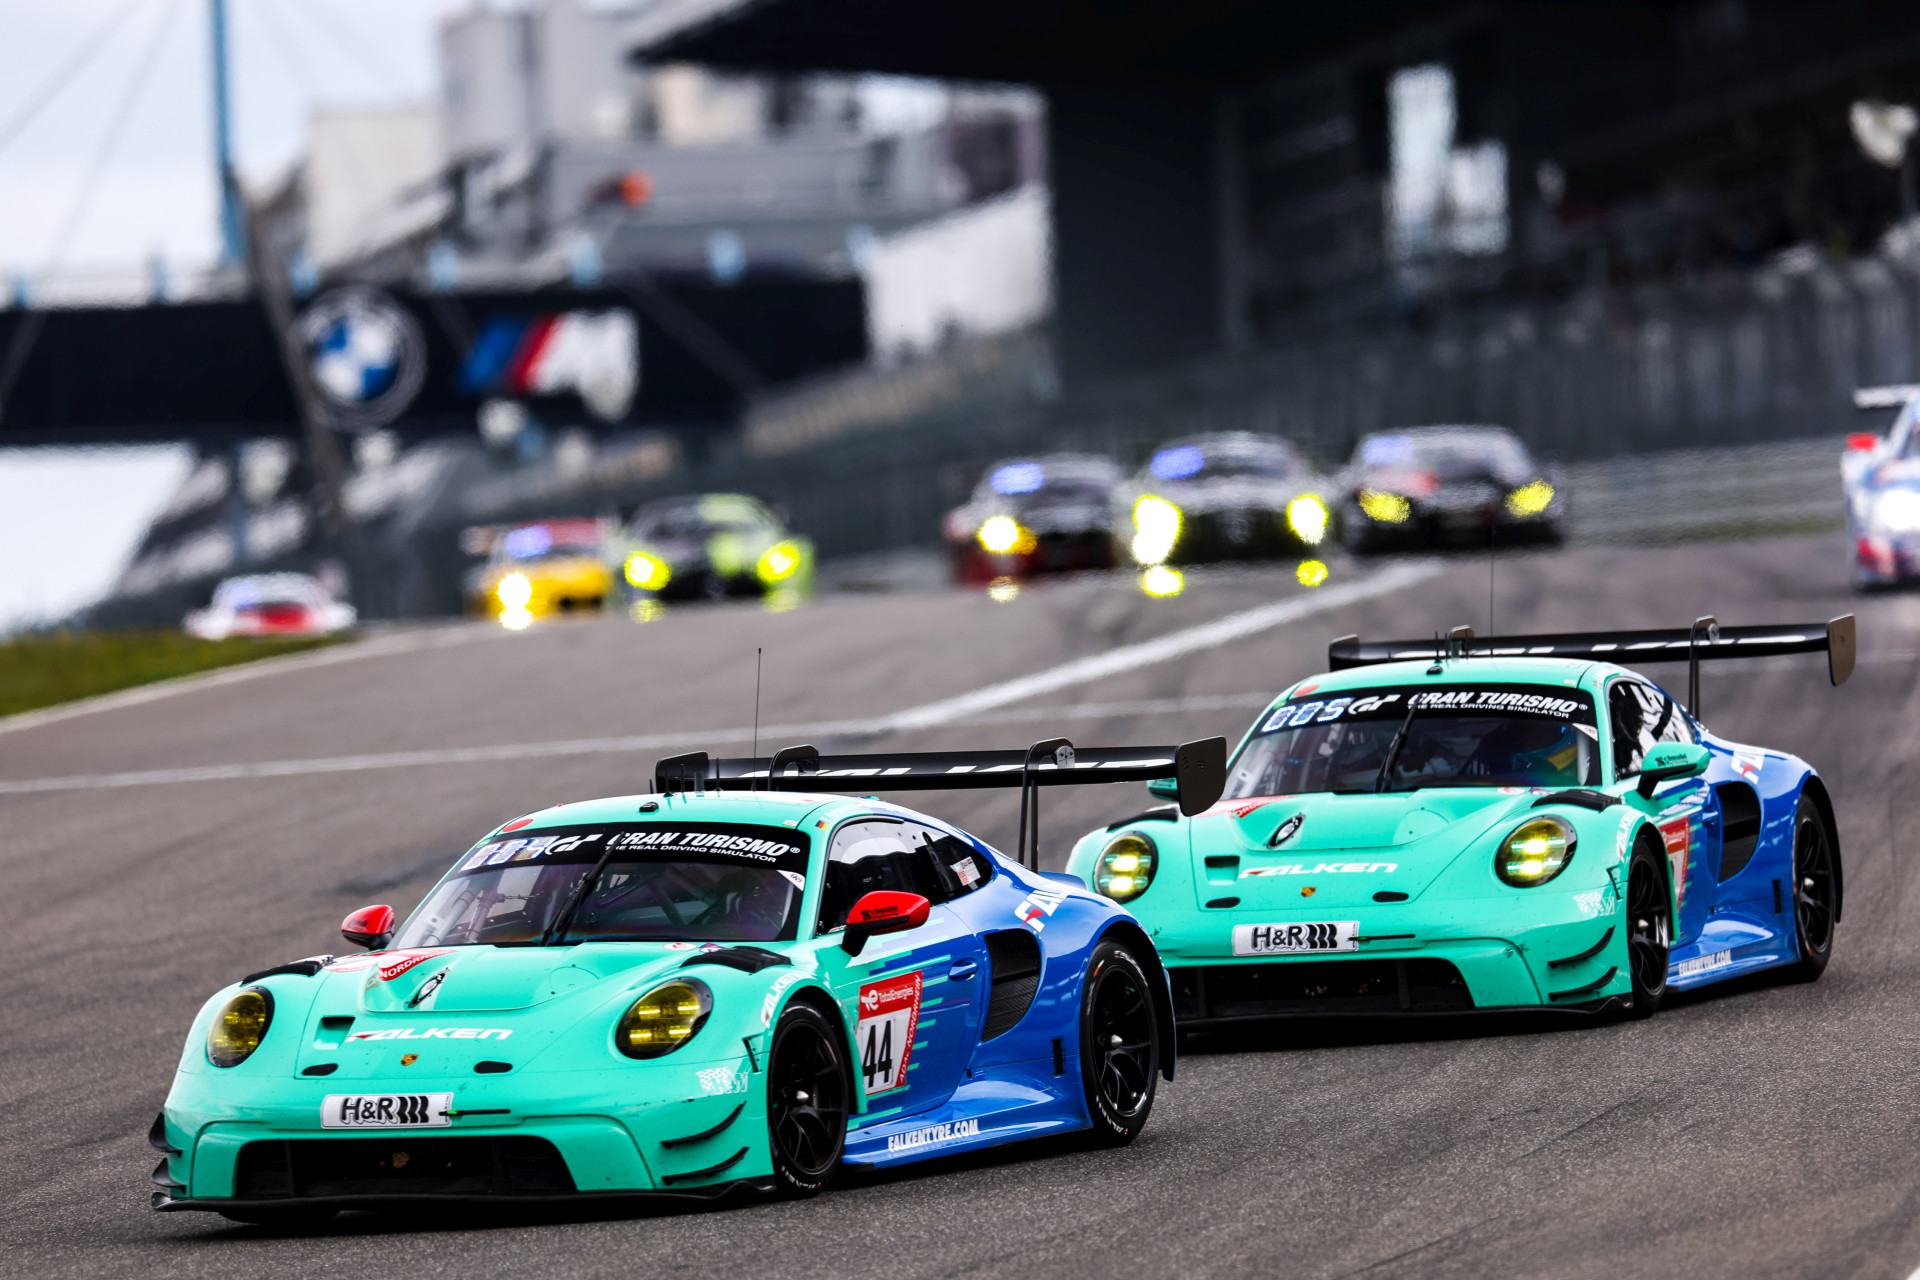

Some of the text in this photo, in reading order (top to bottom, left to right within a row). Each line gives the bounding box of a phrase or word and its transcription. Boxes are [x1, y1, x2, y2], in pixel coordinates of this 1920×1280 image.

[661, 845, 707, 853] DRIVING
[709, 848, 777, 863] SIMULATOR
[1239, 863, 1398, 879] FALKEN
[1252, 926, 1303, 950] H&R
[343, 1028, 513, 1043] FALKEN
[863, 1020, 893, 1089] 44
[340, 1097, 395, 1124] H&R
[888, 1119, 980, 1152] FALKENTYRE.COM
